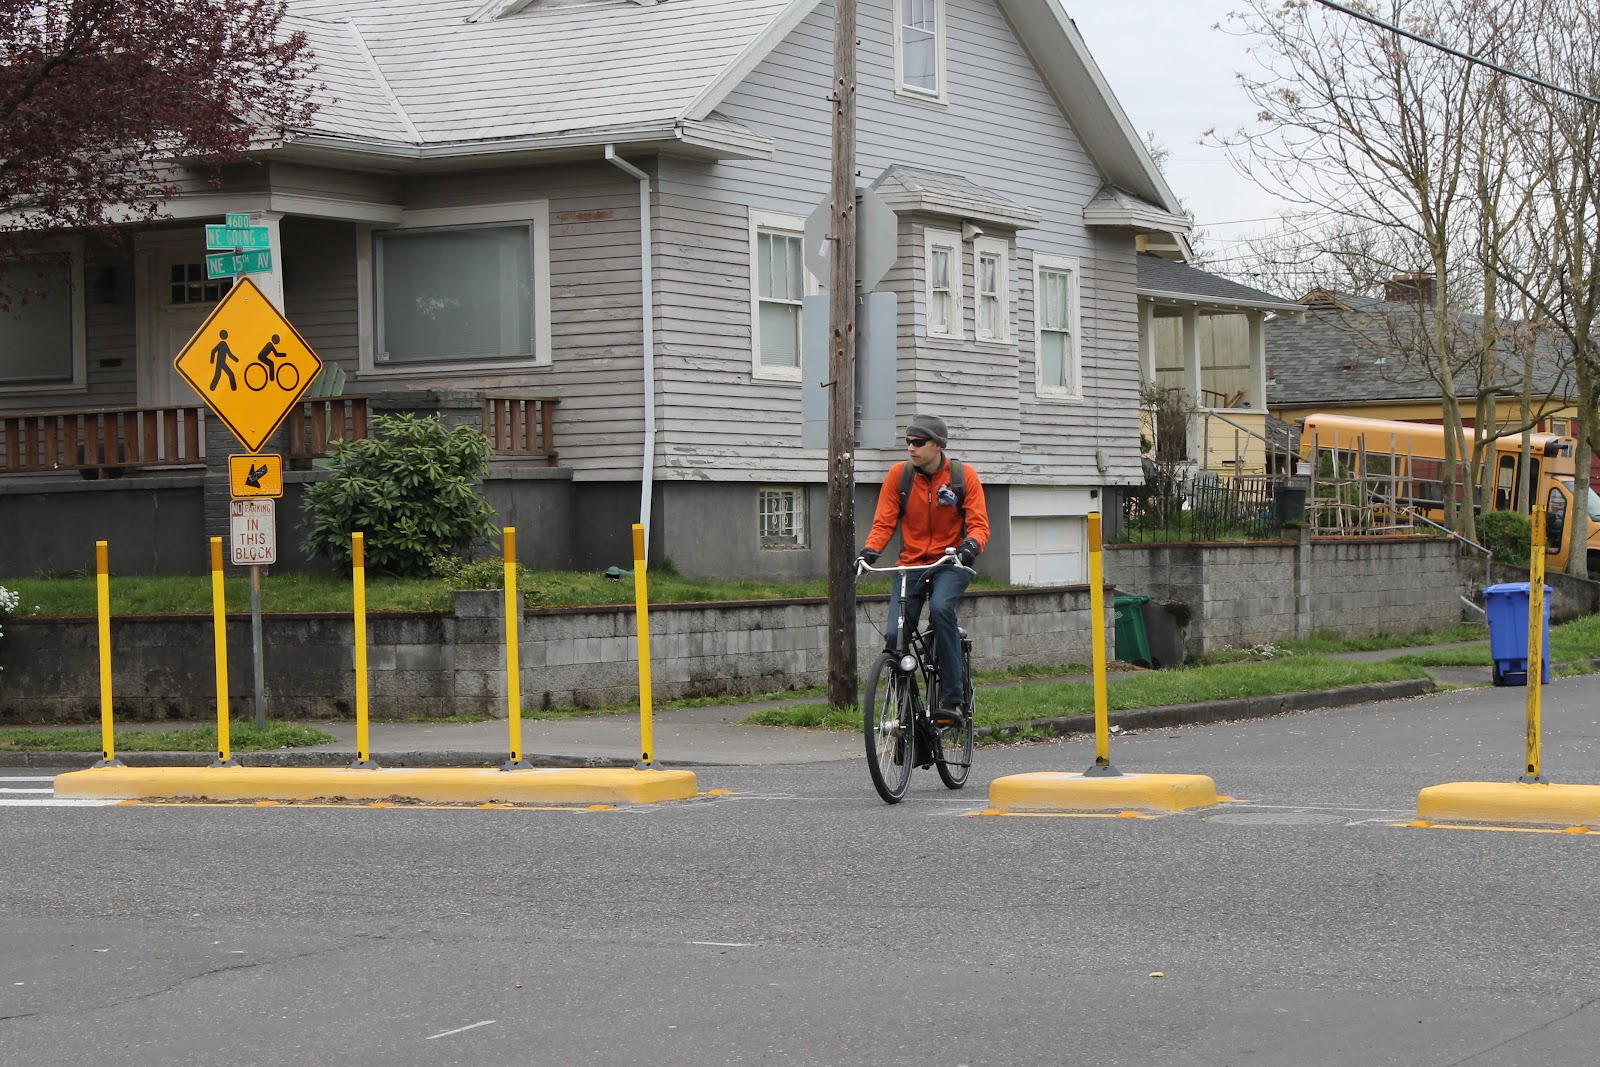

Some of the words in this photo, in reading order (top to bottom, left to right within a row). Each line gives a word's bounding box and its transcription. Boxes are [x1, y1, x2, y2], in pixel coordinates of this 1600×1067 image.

[227, 216, 249, 228] 4600
[208, 229, 222, 245] NE
[227, 229, 256, 245] GOING
[210, 258, 225, 274] NE
[232, 255, 249, 271] 15TH
[257, 252, 269, 269] AV
[232, 502, 243, 515] NO
[245, 503, 271, 513] PARKING
[247, 519, 259, 531] IN
[240, 533, 266, 545] THIS
[235, 547, 272, 560] BLOCK
